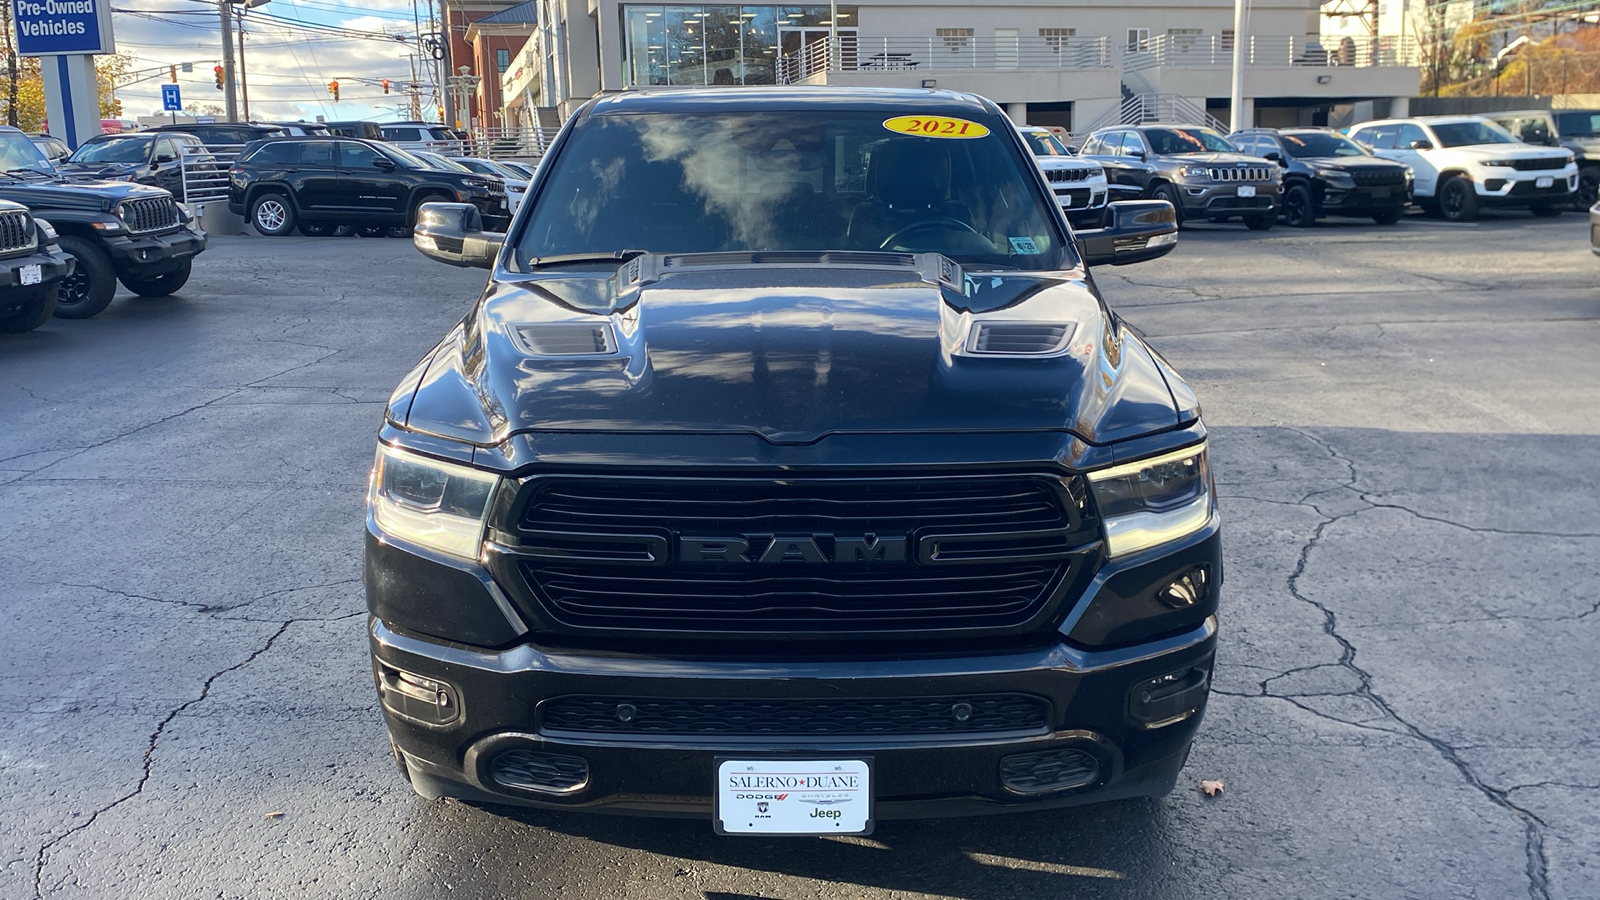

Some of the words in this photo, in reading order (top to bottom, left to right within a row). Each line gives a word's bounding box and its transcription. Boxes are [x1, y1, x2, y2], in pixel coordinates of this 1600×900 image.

[17, 0, 93, 16] Pre-Owned
[20, 19, 86, 36] Vehicles
[166, 90, 177, 103] H
[905, 120, 970, 135] 2021
[680, 534, 906, 562] RAM
[729, 776, 797, 788] SALERNO
[806, 776, 859, 788] DUANE
[810, 807, 841, 819] Jeep
